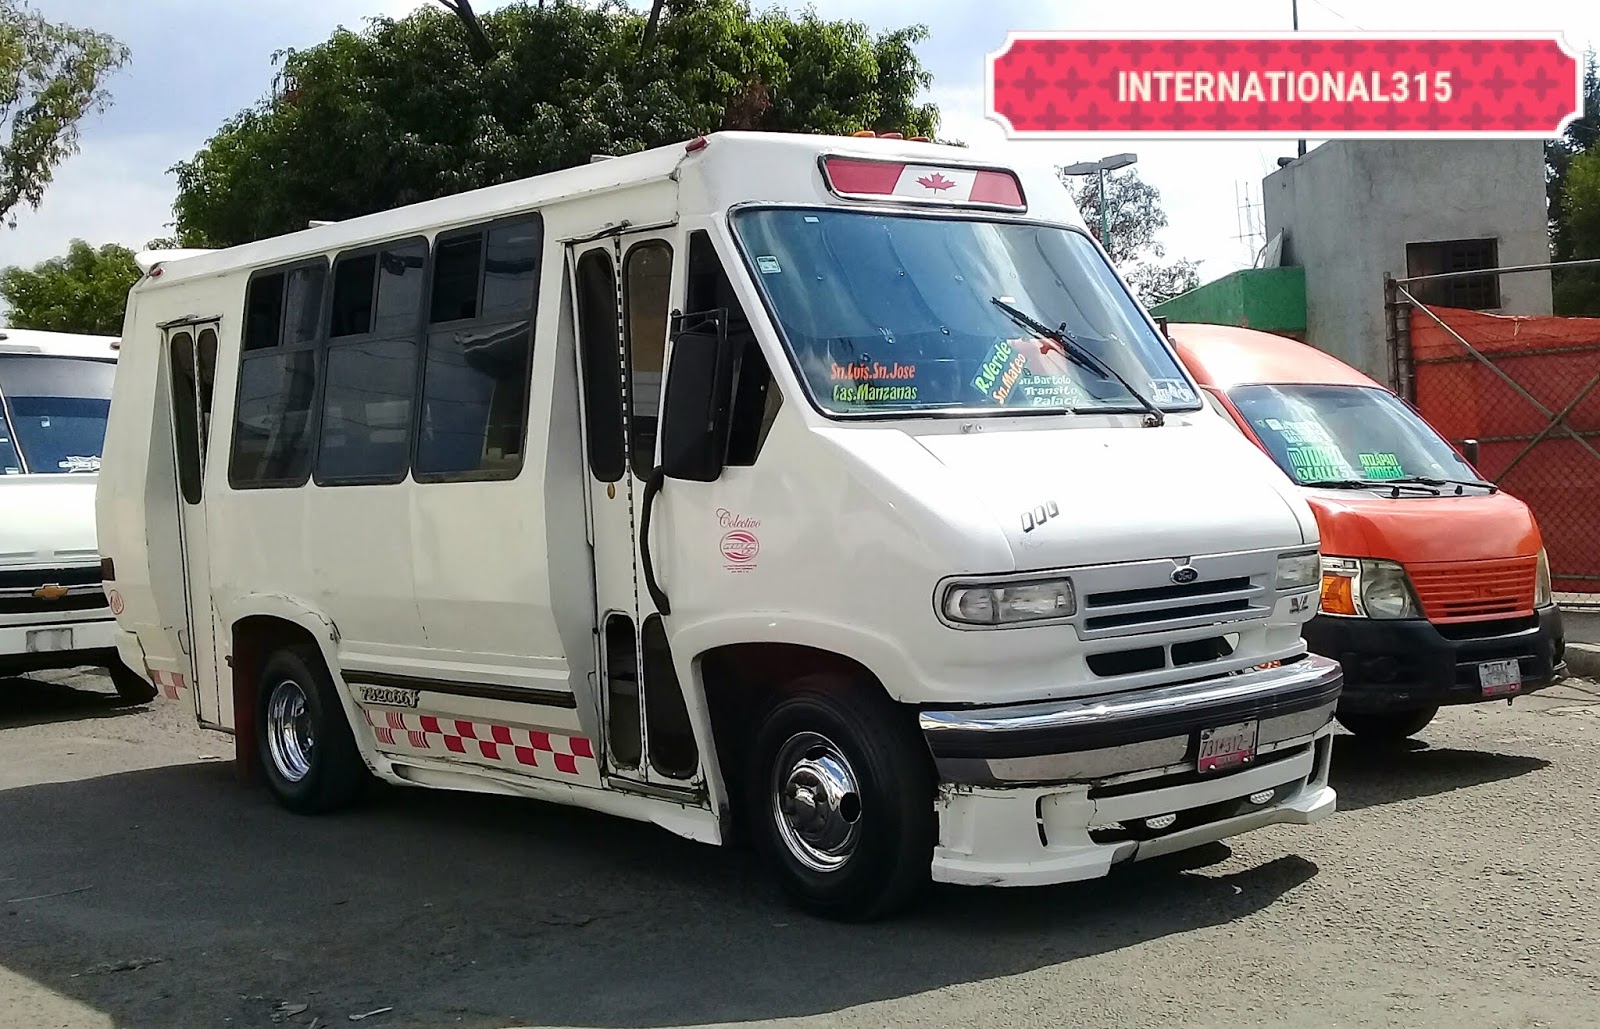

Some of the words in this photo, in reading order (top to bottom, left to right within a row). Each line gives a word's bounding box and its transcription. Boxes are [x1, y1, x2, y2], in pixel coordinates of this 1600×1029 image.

[974, 340, 1012, 395] R.Verde
[992, 353, 1027, 405] Sn.Mateo
[715, 507, 761, 528] Colectivo
